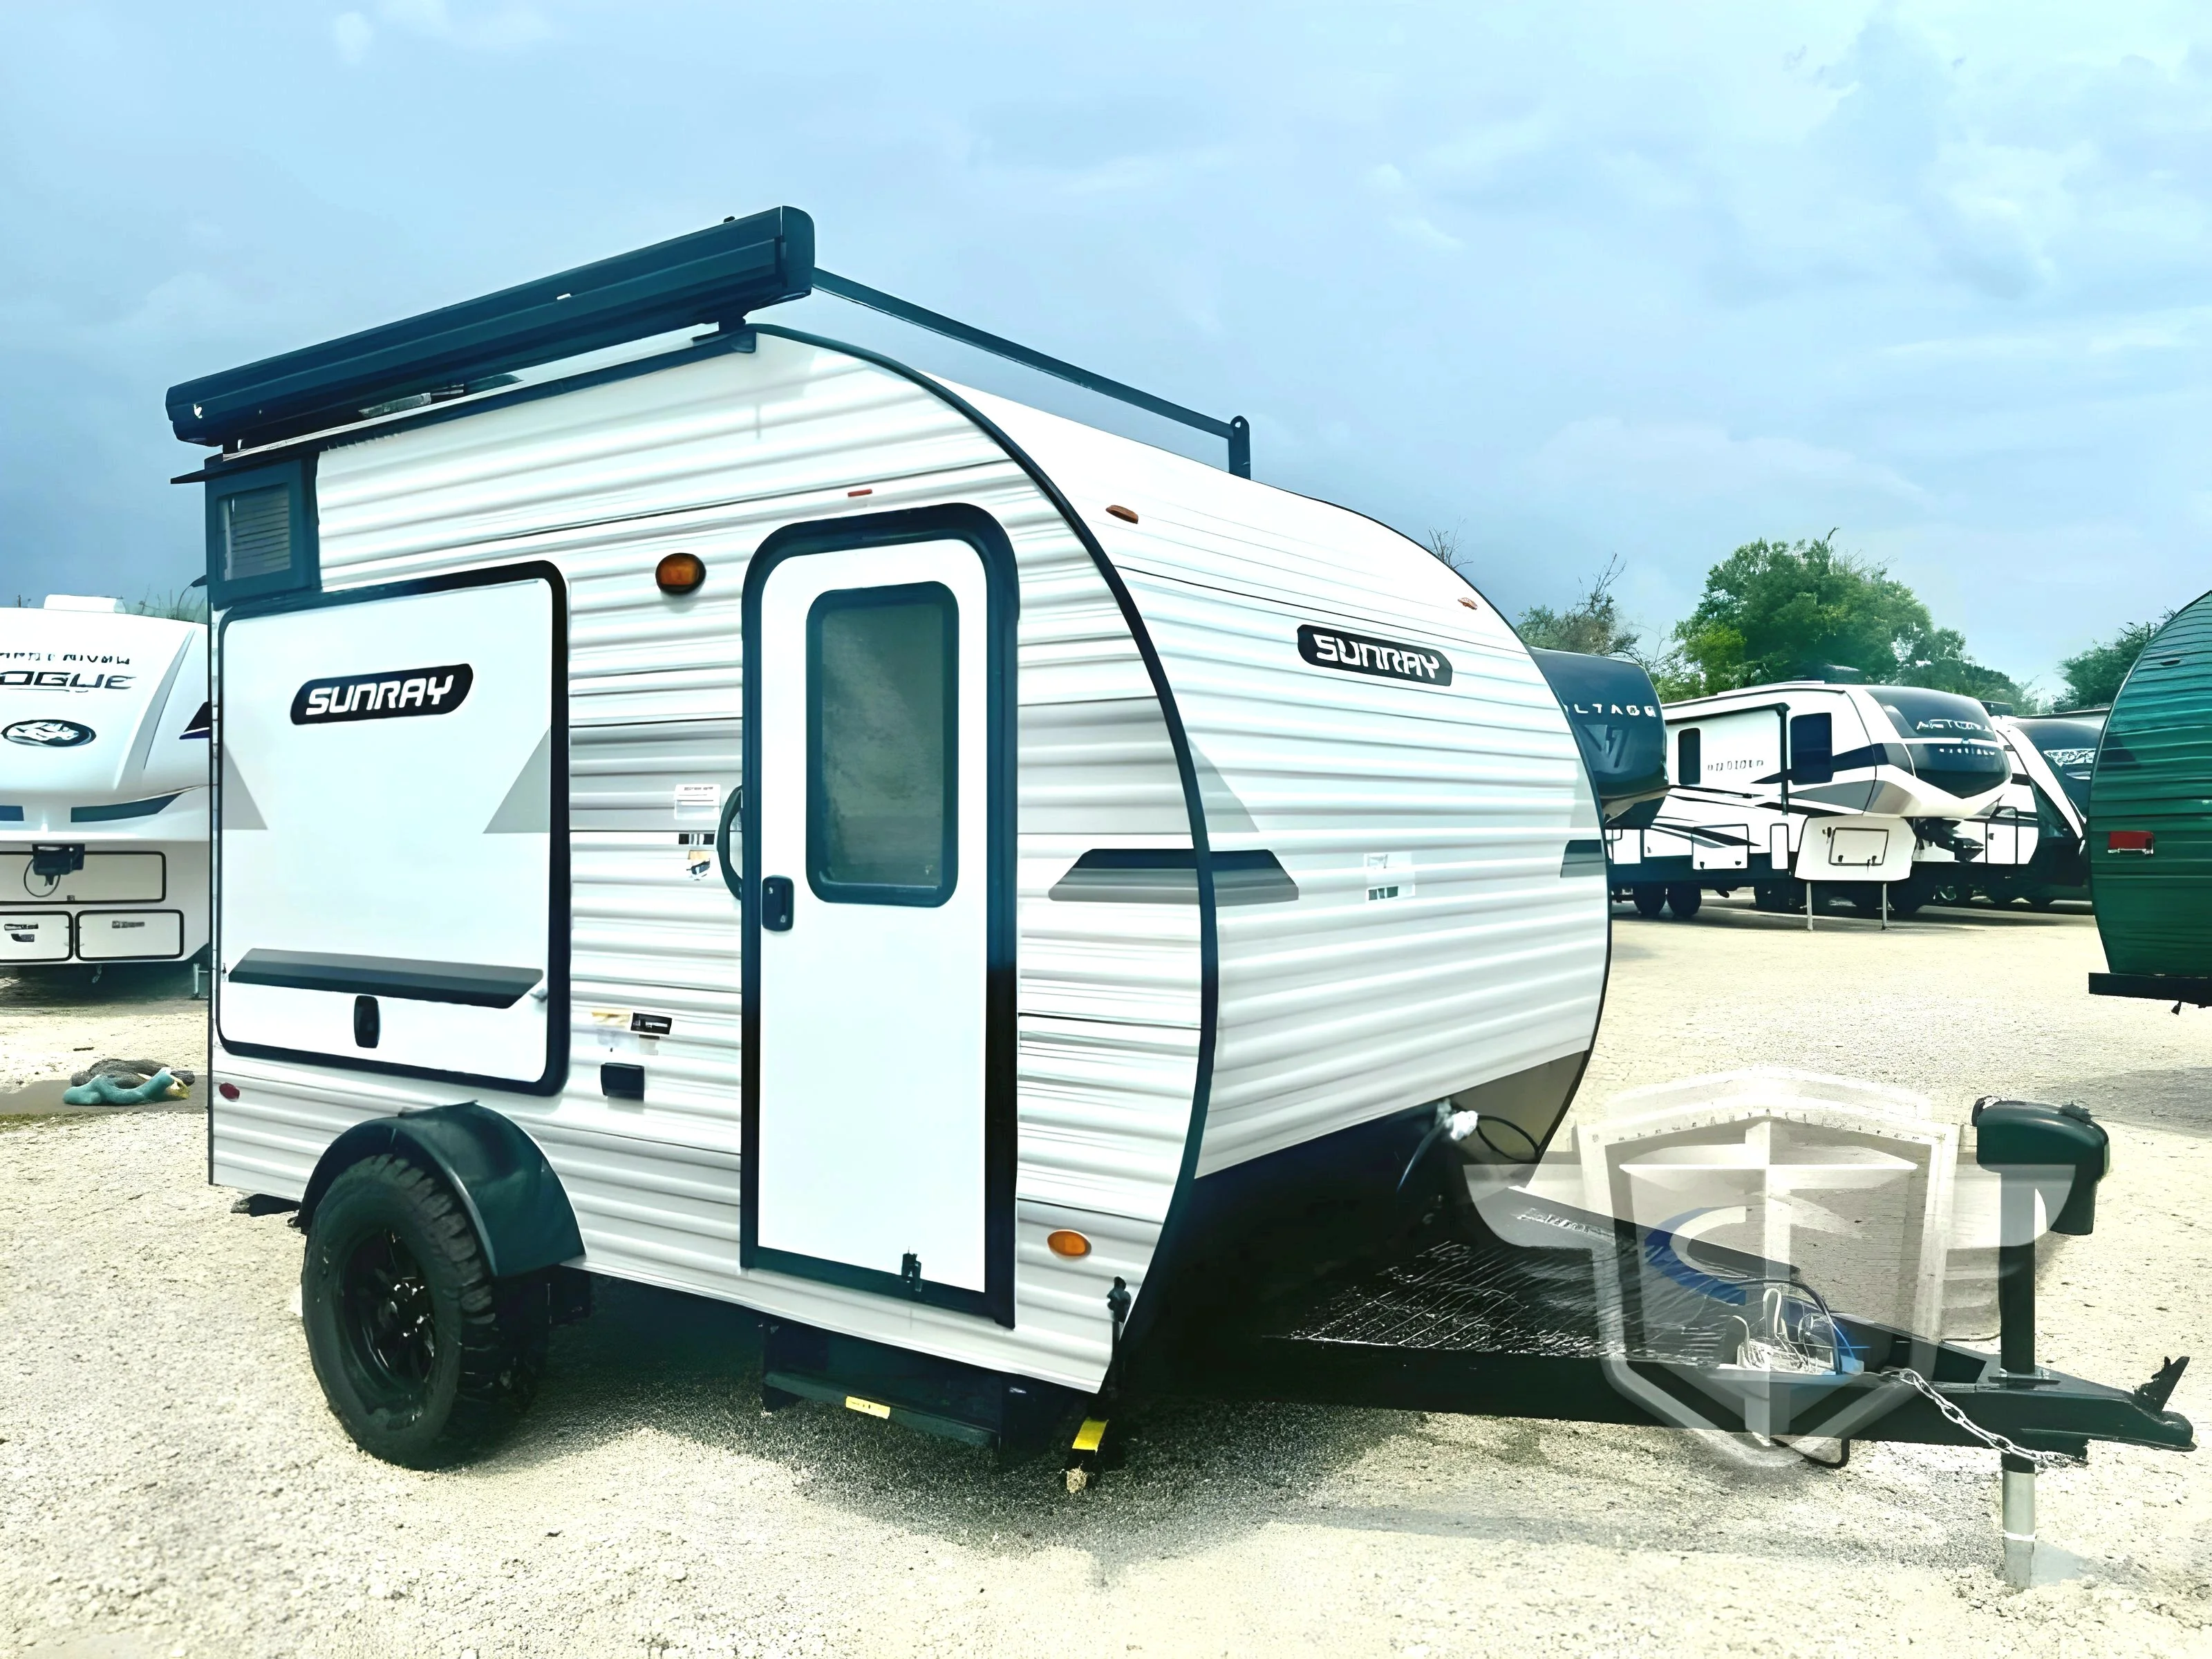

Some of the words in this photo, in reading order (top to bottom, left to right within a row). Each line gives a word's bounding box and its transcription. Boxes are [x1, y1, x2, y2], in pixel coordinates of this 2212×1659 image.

[1313, 634, 1440, 679] SUNRAY
[0, 671, 136, 690] OGUE
[306, 675, 453, 715] SUNRAY
